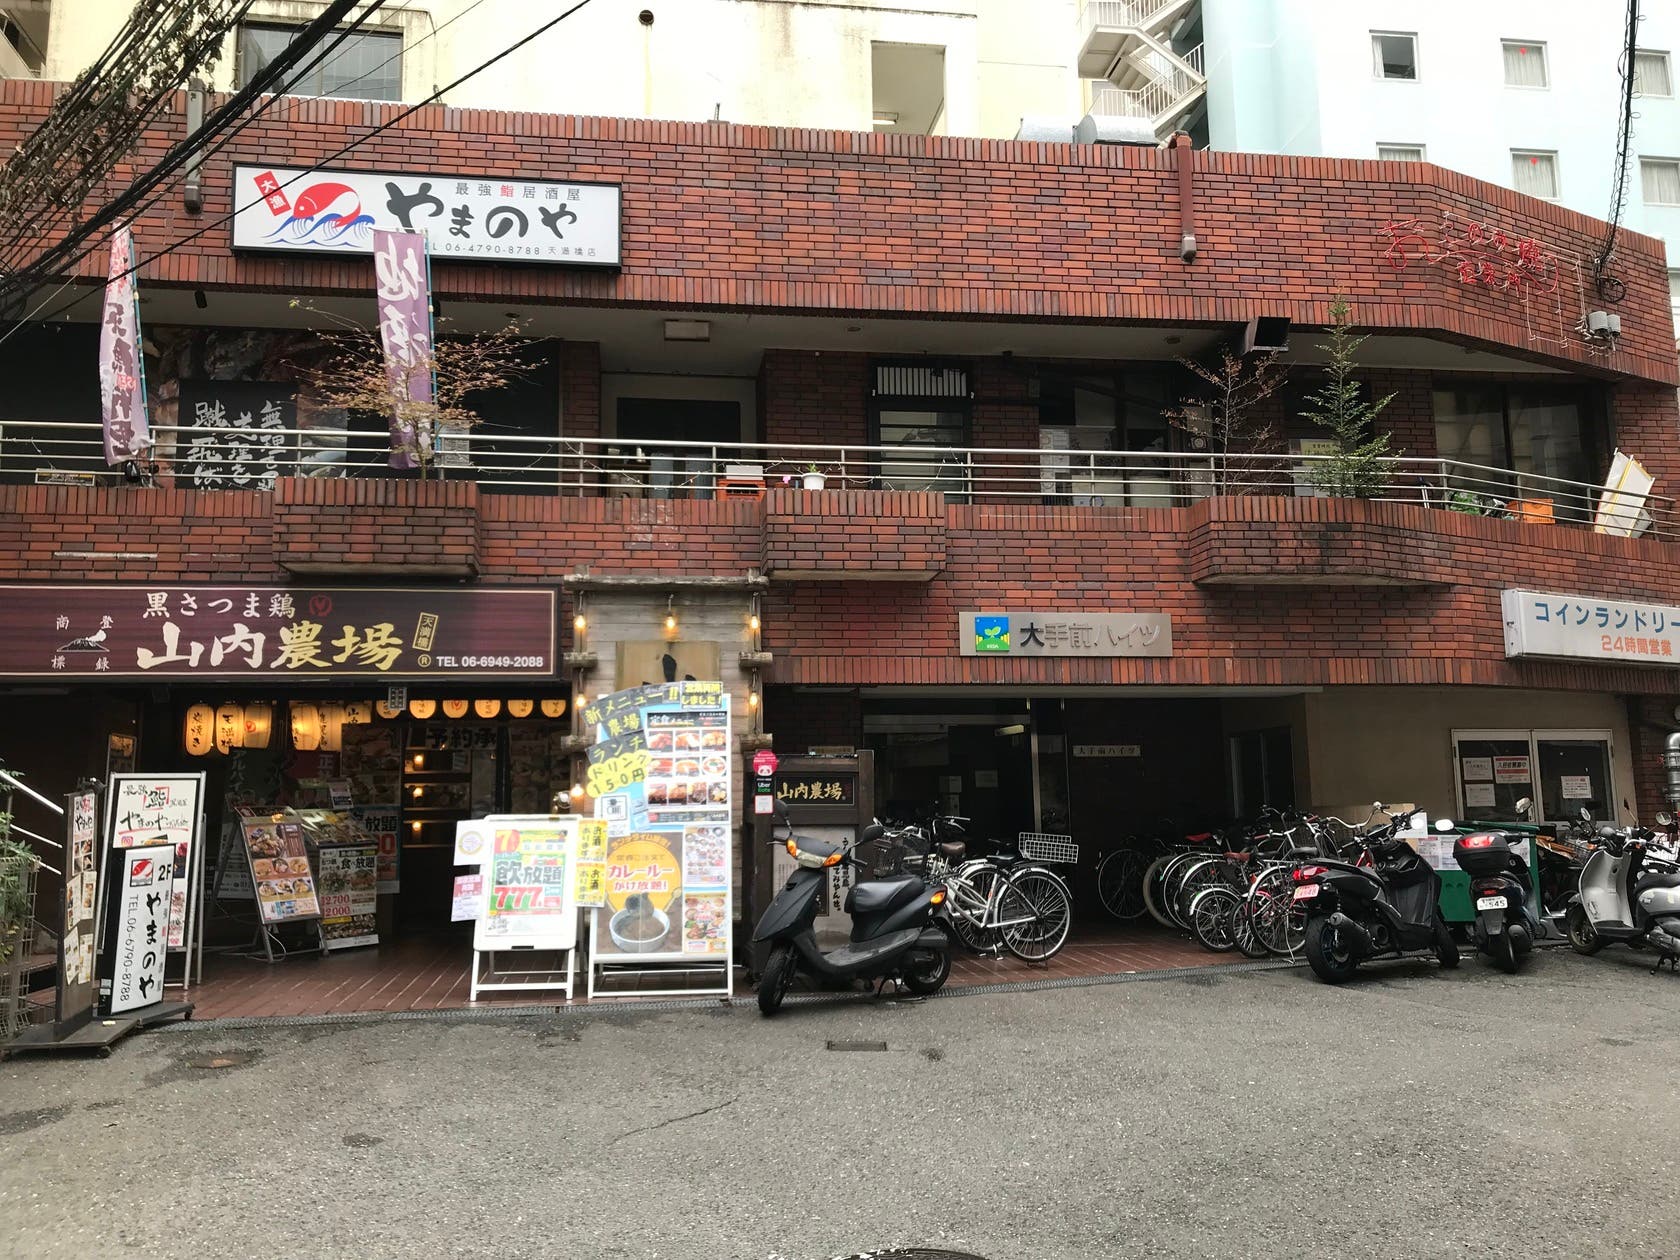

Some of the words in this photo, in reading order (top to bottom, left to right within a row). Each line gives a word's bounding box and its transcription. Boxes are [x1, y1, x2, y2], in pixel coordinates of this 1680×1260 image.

[385, 181, 578, 240] やまのや
[445, 243, 540, 255] 06-4790-8788
[143, 591, 296, 619] 黒さつま鶏
[1535, 602, 1680, 634] コインランドリー
[136, 620, 403, 671] 山内農場
[1601, 634, 1673, 656] 24時間営業
[437, 656, 459, 667] TEL
[462, 656, 543, 668] 06-6949-2088
[777, 781, 842, 800] 山内農場
[158, 863, 172, 882] 2F
[609, 864, 673, 880] カレールー
[138, 891, 162, 1000] やまのや
